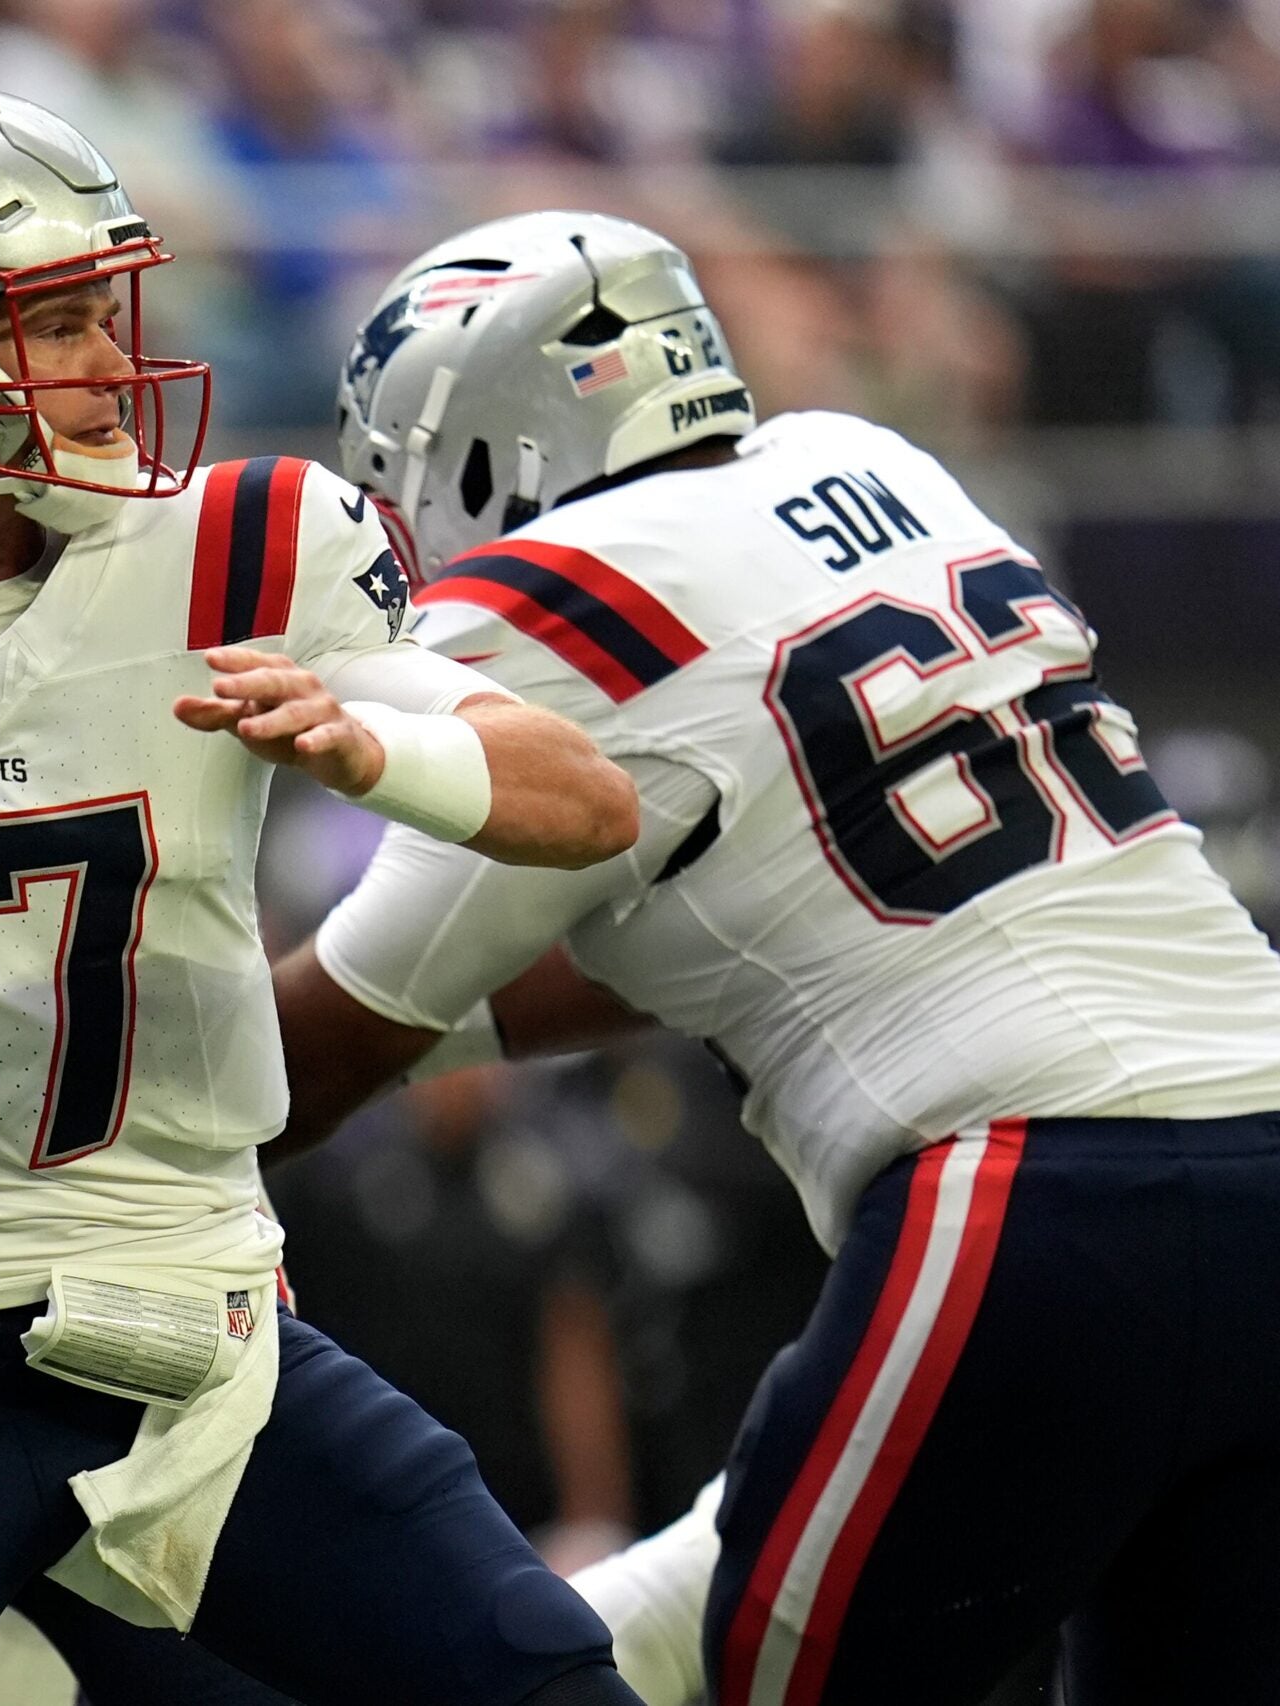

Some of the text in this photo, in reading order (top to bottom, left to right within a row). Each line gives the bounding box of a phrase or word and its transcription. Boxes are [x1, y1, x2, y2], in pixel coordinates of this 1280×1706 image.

[774, 470, 932, 572] SOW
[762, 547, 1180, 926] 62
[227, 1310, 253, 1336] NFL
